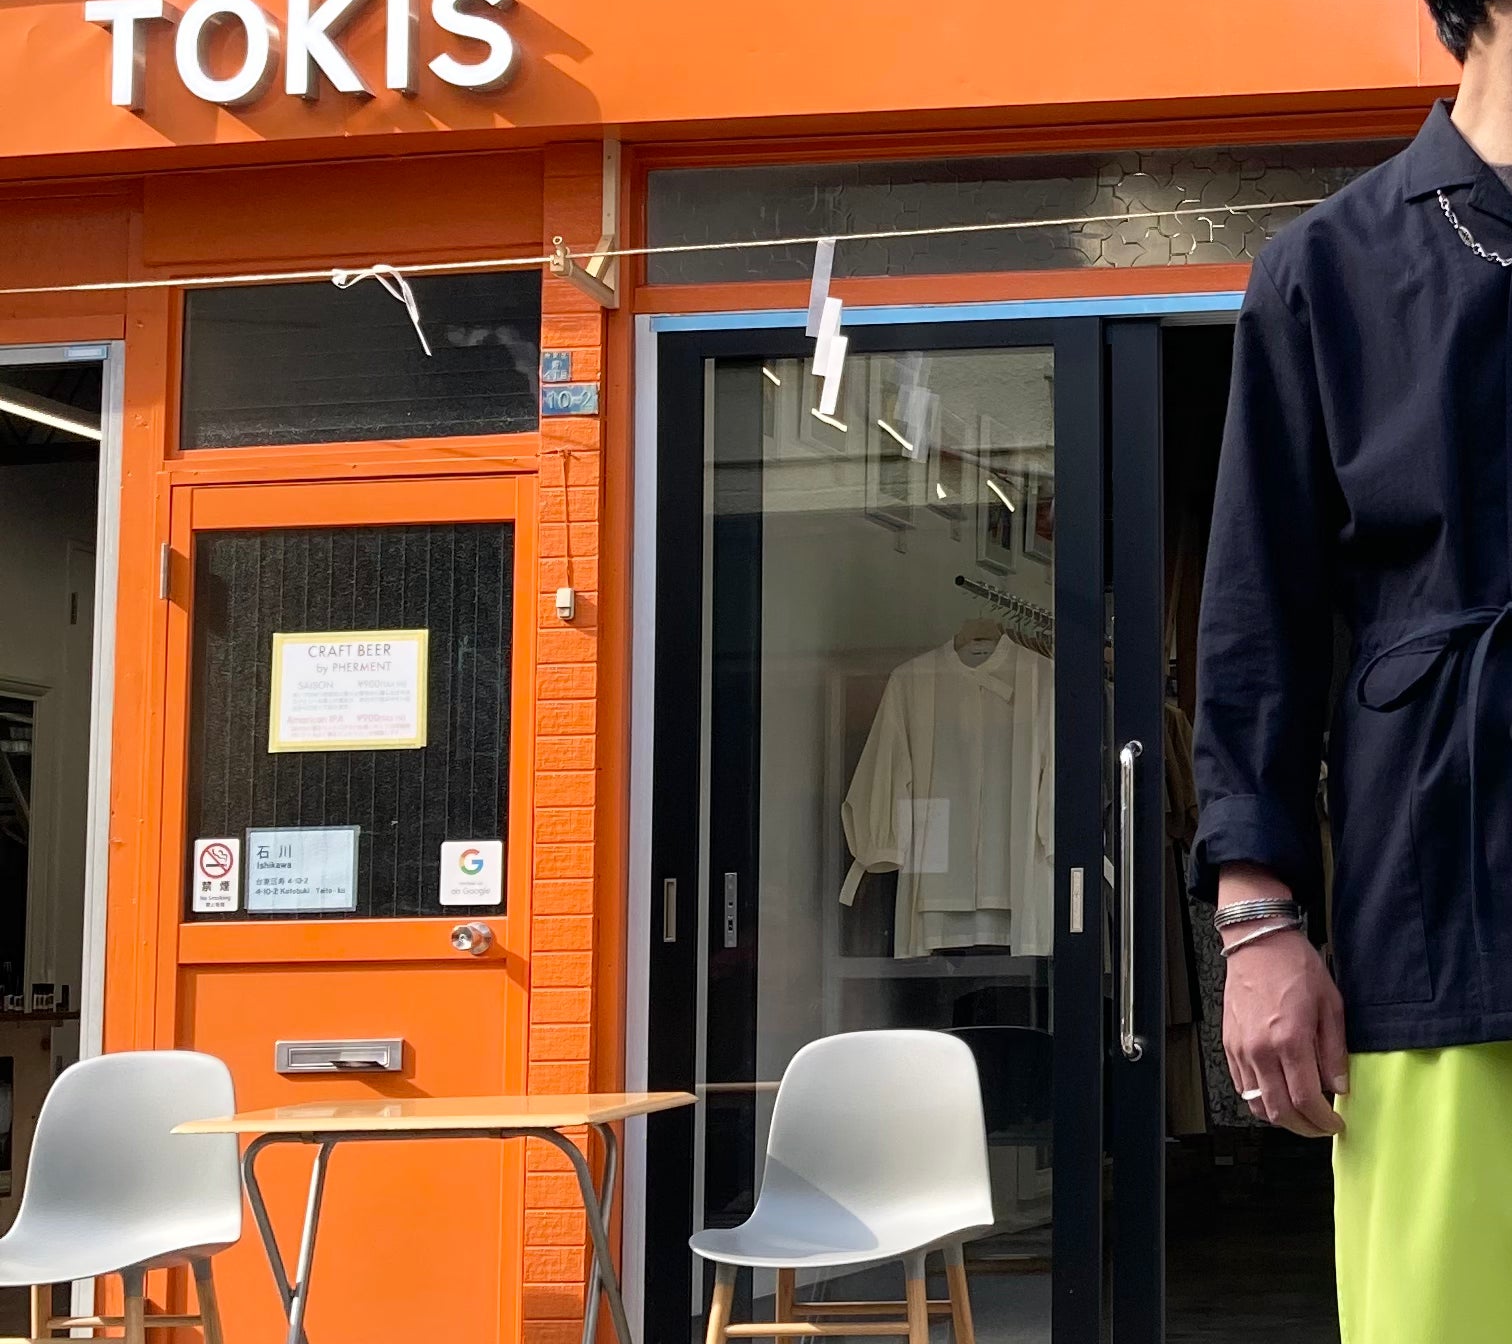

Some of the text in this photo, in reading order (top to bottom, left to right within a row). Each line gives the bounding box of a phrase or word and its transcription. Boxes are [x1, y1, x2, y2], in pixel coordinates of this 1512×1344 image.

[547, 390, 593, 409] 10-2
[308, 643, 391, 659] CRAFT BEER
[316, 661, 393, 675] by PHERMENT
[257, 845, 292, 859] 石川
[257, 861, 292, 869] Ishikawa
[201, 881, 230, 892] 禁煙
